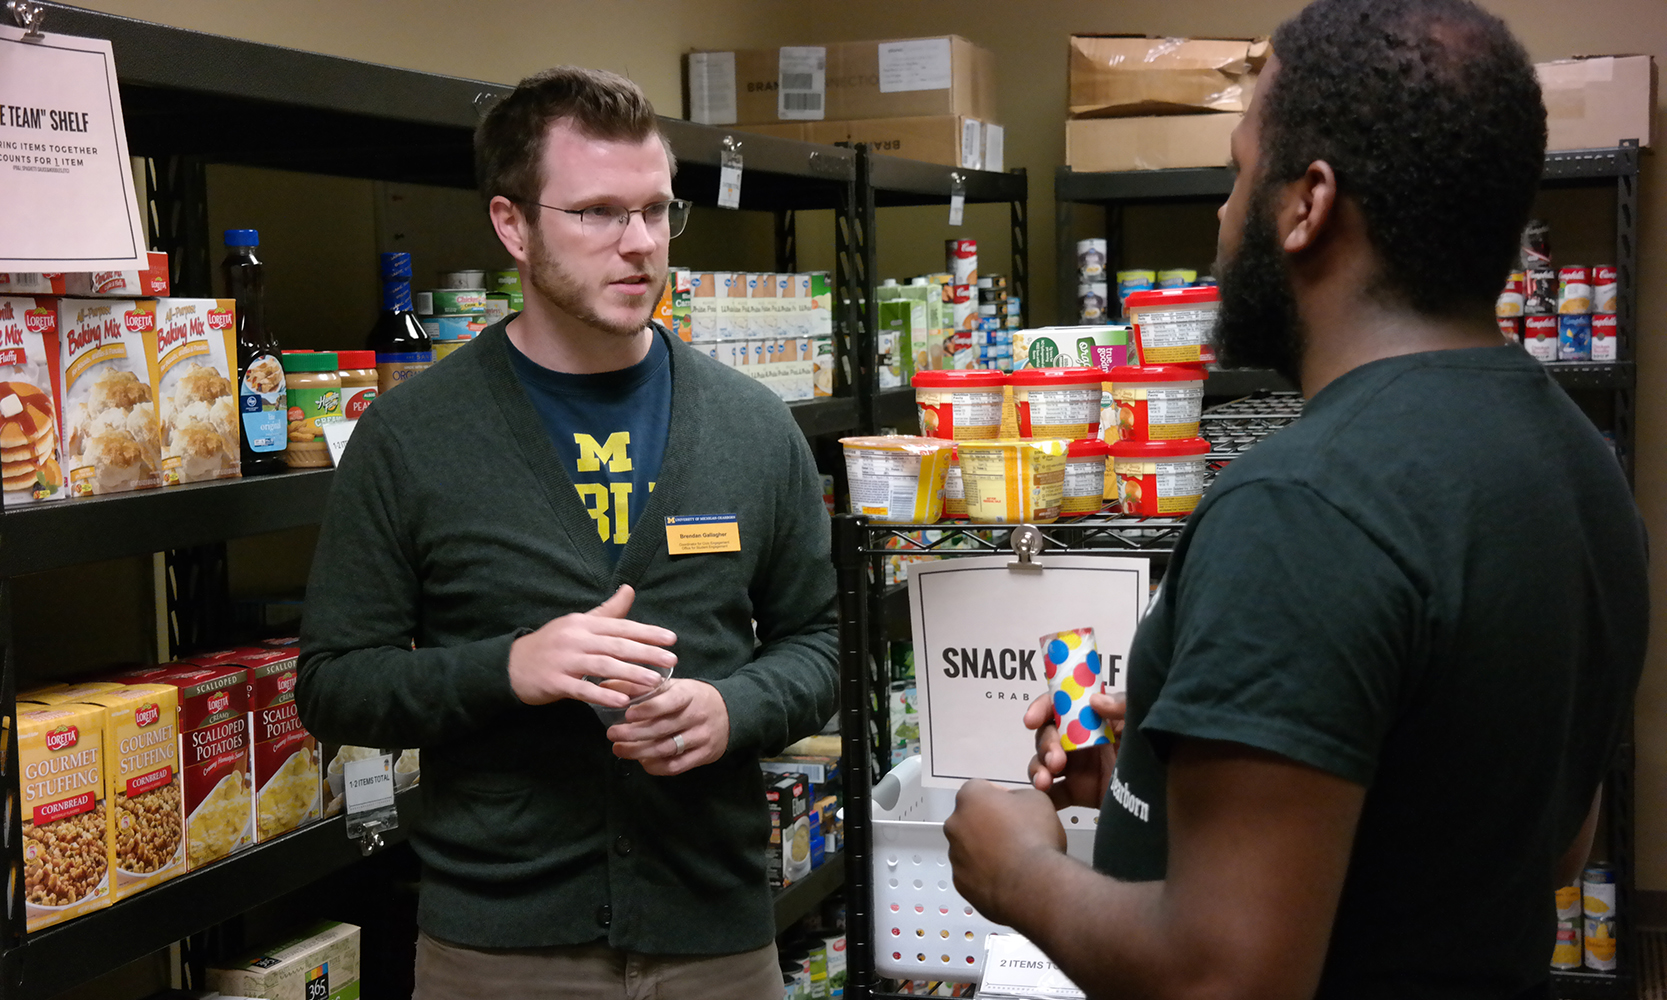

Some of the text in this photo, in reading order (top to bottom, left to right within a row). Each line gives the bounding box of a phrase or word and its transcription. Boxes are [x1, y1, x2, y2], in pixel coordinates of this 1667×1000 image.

[49, 109, 89, 133] SHELF
[20, 143, 46, 151] ITEMS
[49, 145, 98, 154] TOGETHER
[34, 156, 51, 164] FOR
[54, 158, 60, 167] 1
[61, 158, 84, 166] ITEM
[26, 315, 55, 327] LORETTA
[125, 315, 153, 327] LORETTA
[208, 313, 233, 325] LORETTA
[5, 323, 23, 346] Mix
[66, 317, 121, 356] Baking Mix
[157, 317, 205, 353] Baking Mix
[1105, 347, 1113, 363] true
[573, 431, 632, 473] M
[941, 647, 1037, 681] SNACK
[196, 675, 238, 694] SCALLOPED
[208, 695, 230, 711] LORETTA
[985, 691, 1030, 701] GRAB
[136, 707, 158, 723] LORETTA
[47, 730, 77, 747] LORETTA
[120, 724, 173, 754] GOURMET
[192, 719, 245, 748] SCALLOPED
[196, 734, 243, 761] POTATOES
[25, 748, 98, 779] GOURMET
[120, 743, 174, 774] STUFFING
[26, 767, 99, 801] STUFFING
[132, 769, 168, 789] CORNBREAD
[358, 777, 374, 787] ITEMS
[374, 774, 390, 783] TOTAL
[41, 795, 89, 816] CORNBREAD
[1000, 959, 1007, 968] 2
[1008, 960, 1044, 970] ITEMS
[308, 978, 326, 1000] 365
